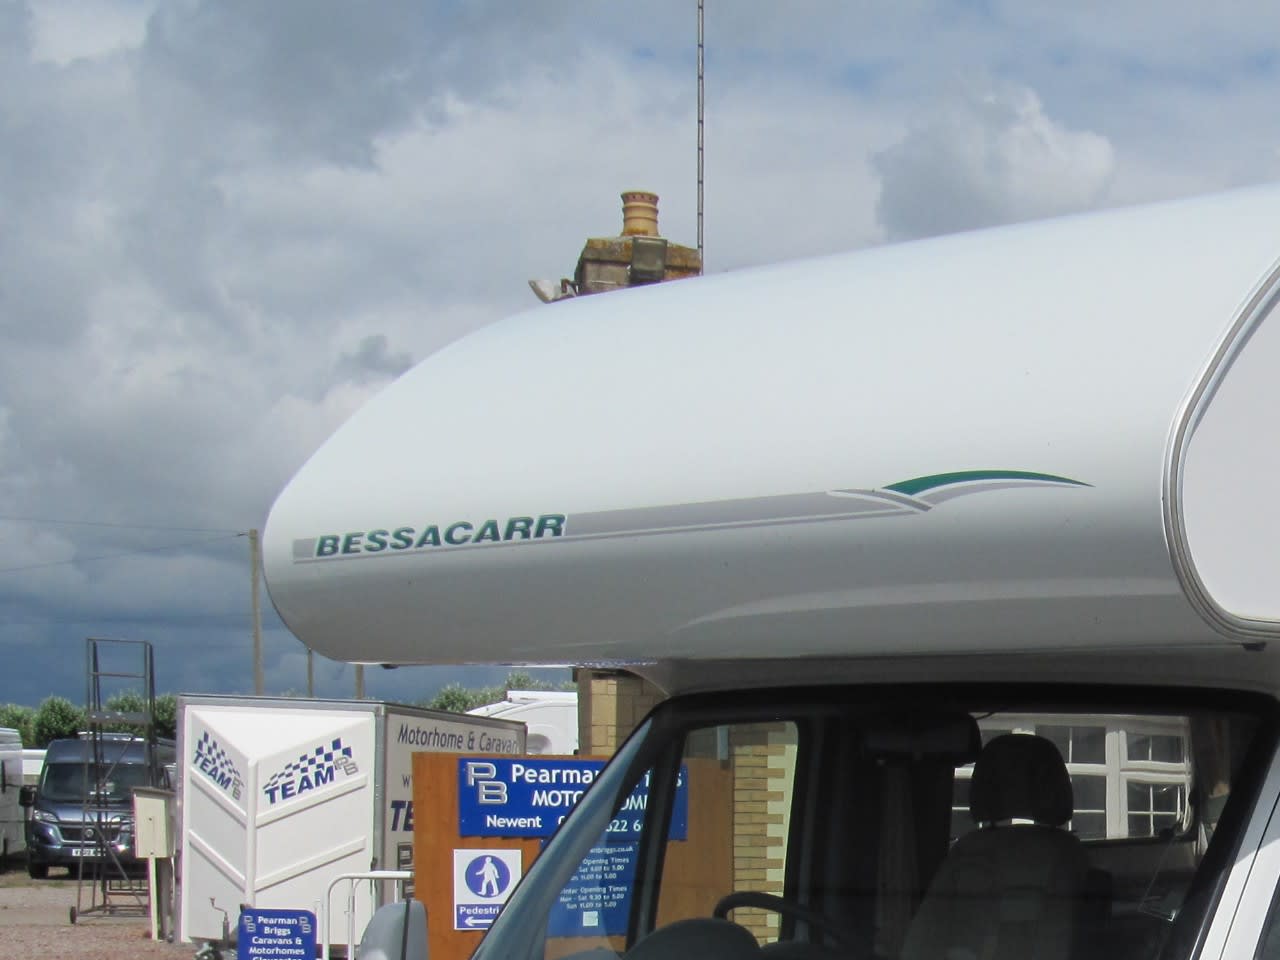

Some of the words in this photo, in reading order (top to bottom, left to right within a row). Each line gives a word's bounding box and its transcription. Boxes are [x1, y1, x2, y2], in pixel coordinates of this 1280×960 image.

[315, 513, 567, 558] BESSACARR
[398, 724, 463, 749] Motorhome
[467, 732, 475, 750] &
[193, 750, 233, 791] TEAM
[511, 764, 600, 783] Pearma
[265, 766, 336, 805] TEAM
[467, 762, 508, 804] PB
[486, 815, 542, 828] Newent
[582, 858, 609, 866] Opening
[611, 856, 630, 864] Times
[459, 906, 500, 915] Pedestri
[258, 916, 297, 925] Pearman
[264, 927, 291, 936] Briggs
[252, 936, 293, 945] Caravans
[296, 937, 302, 945] &
[249, 947, 305, 955] Motorhomes
